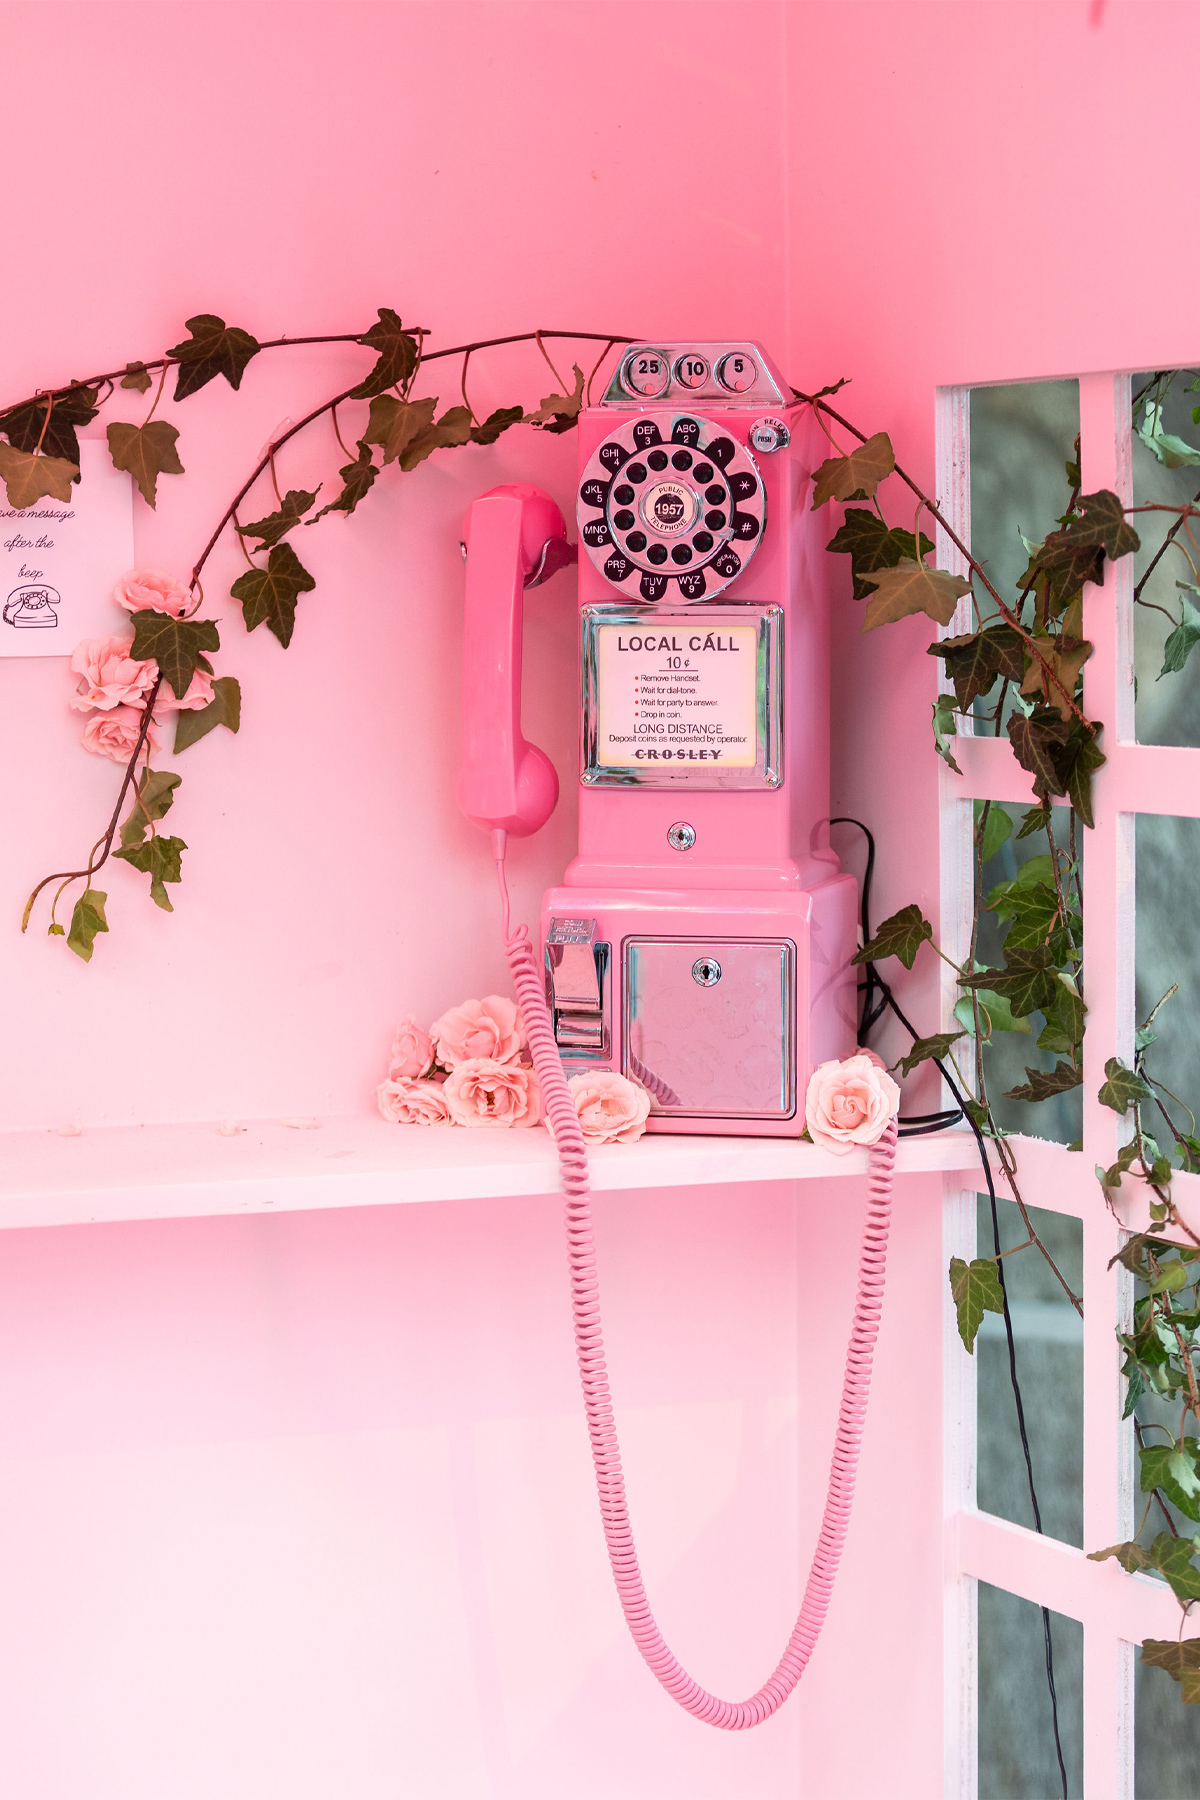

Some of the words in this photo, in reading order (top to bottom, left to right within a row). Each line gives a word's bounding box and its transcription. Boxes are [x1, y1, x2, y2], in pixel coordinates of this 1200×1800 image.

[638, 360, 659, 373] 25
[687, 362, 704, 375] 10
[734, 359, 743, 372] 5
[637, 426, 656, 435] DEF
[676, 424, 697, 433] ABC
[645, 437, 651, 445] 3
[683, 435, 689, 443] 2
[602, 449, 619, 457] GHI
[717, 449, 722, 457] 1
[614, 458, 620, 466] 4
[585, 486, 602, 494] JKL
[658, 486, 684, 495] PUBLIC
[655, 503, 684, 516] 1957
[17, 510, 26, 518] a
[26, 510, 75, 523] message
[650, 516, 688, 531] TELEPHONE
[741, 522, 752, 533] #
[584, 525, 608, 534] MNO
[4, 534, 33, 552] after
[34, 535, 55, 548] the
[597, 535, 604, 543] 6
[607, 560, 626, 569] PRS
[716, 554, 741, 567] OPERATOR
[18, 564, 44, 581] beep
[617, 569, 624, 578] 7
[725, 564, 733, 574] 0
[643, 577, 663, 586] TUV
[678, 576, 701, 584] WYZ
[649, 587, 655, 595] 8
[688, 585, 695, 593] 9
[618, 636, 683, 651] LOCAL
[666, 656, 682, 669] 10
[670, 674, 701, 682] Handset.
[640, 686, 656, 694] Wait
[656, 686, 666, 694] for
[666, 686, 698, 694] dial-tone.
[640, 698, 656, 706] Wait
[656, 698, 666, 706] for
[666, 699, 685, 707] party
[640, 710, 658, 719] Drop
[658, 710, 665, 718] in
[666, 710, 683, 718] coin.
[633, 723, 665, 734] LONG
[667, 723, 723, 734] DISTANCE
[608, 734, 637, 743] Deposit
[637, 735, 658, 743] coins
[669, 734, 706, 744] requested
[706, 734, 716, 744] by
[634, 749, 722, 760] CROSLEY
